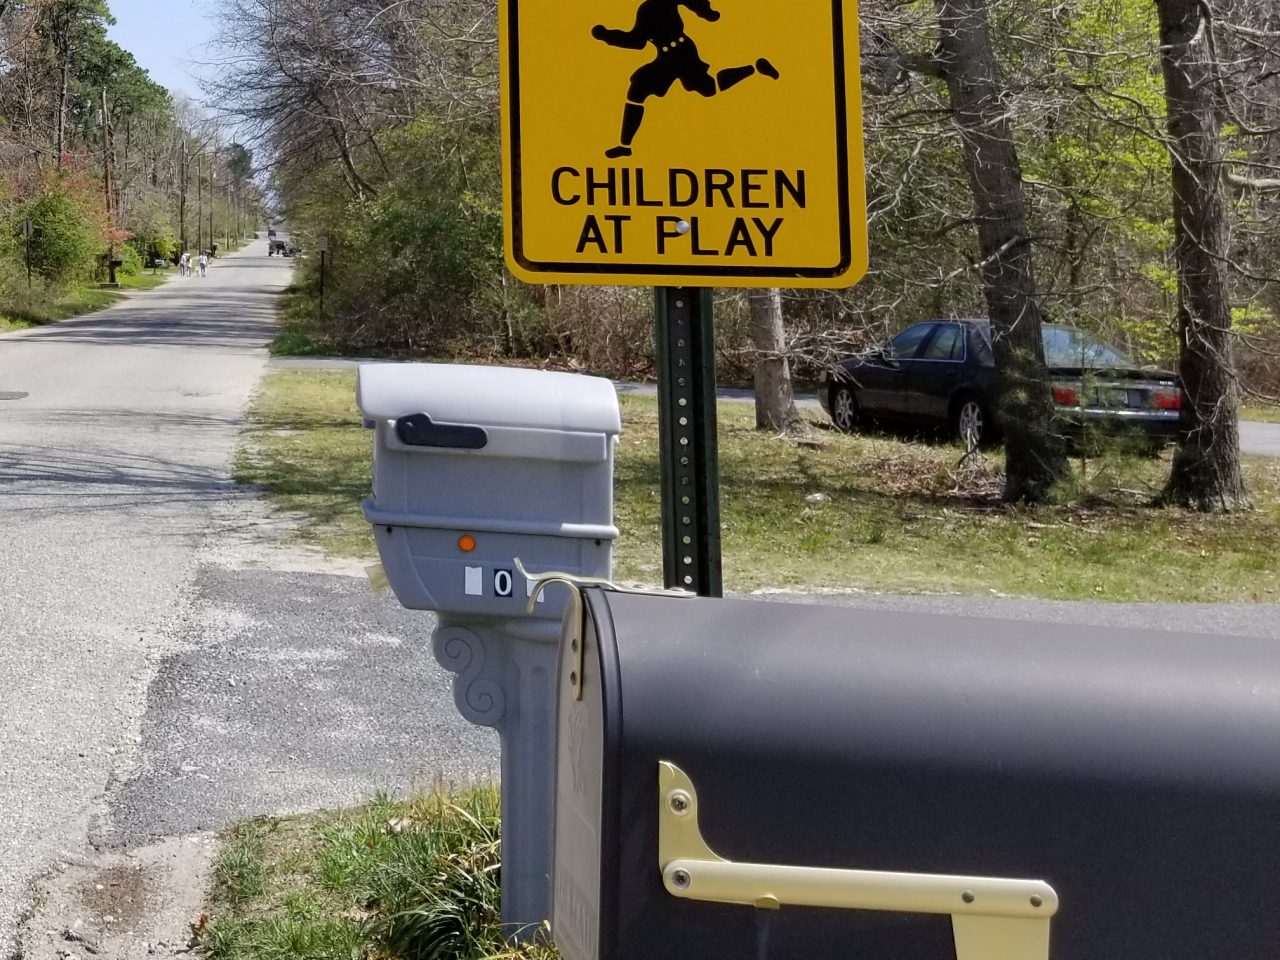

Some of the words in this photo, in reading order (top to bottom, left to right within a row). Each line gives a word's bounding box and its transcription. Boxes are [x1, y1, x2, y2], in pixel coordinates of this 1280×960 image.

[551, 167, 806, 209] CHILDREN
[576, 215, 631, 254] AT
[657, 215, 784, 256] PLAY
[494, 570, 512, 596] 0
